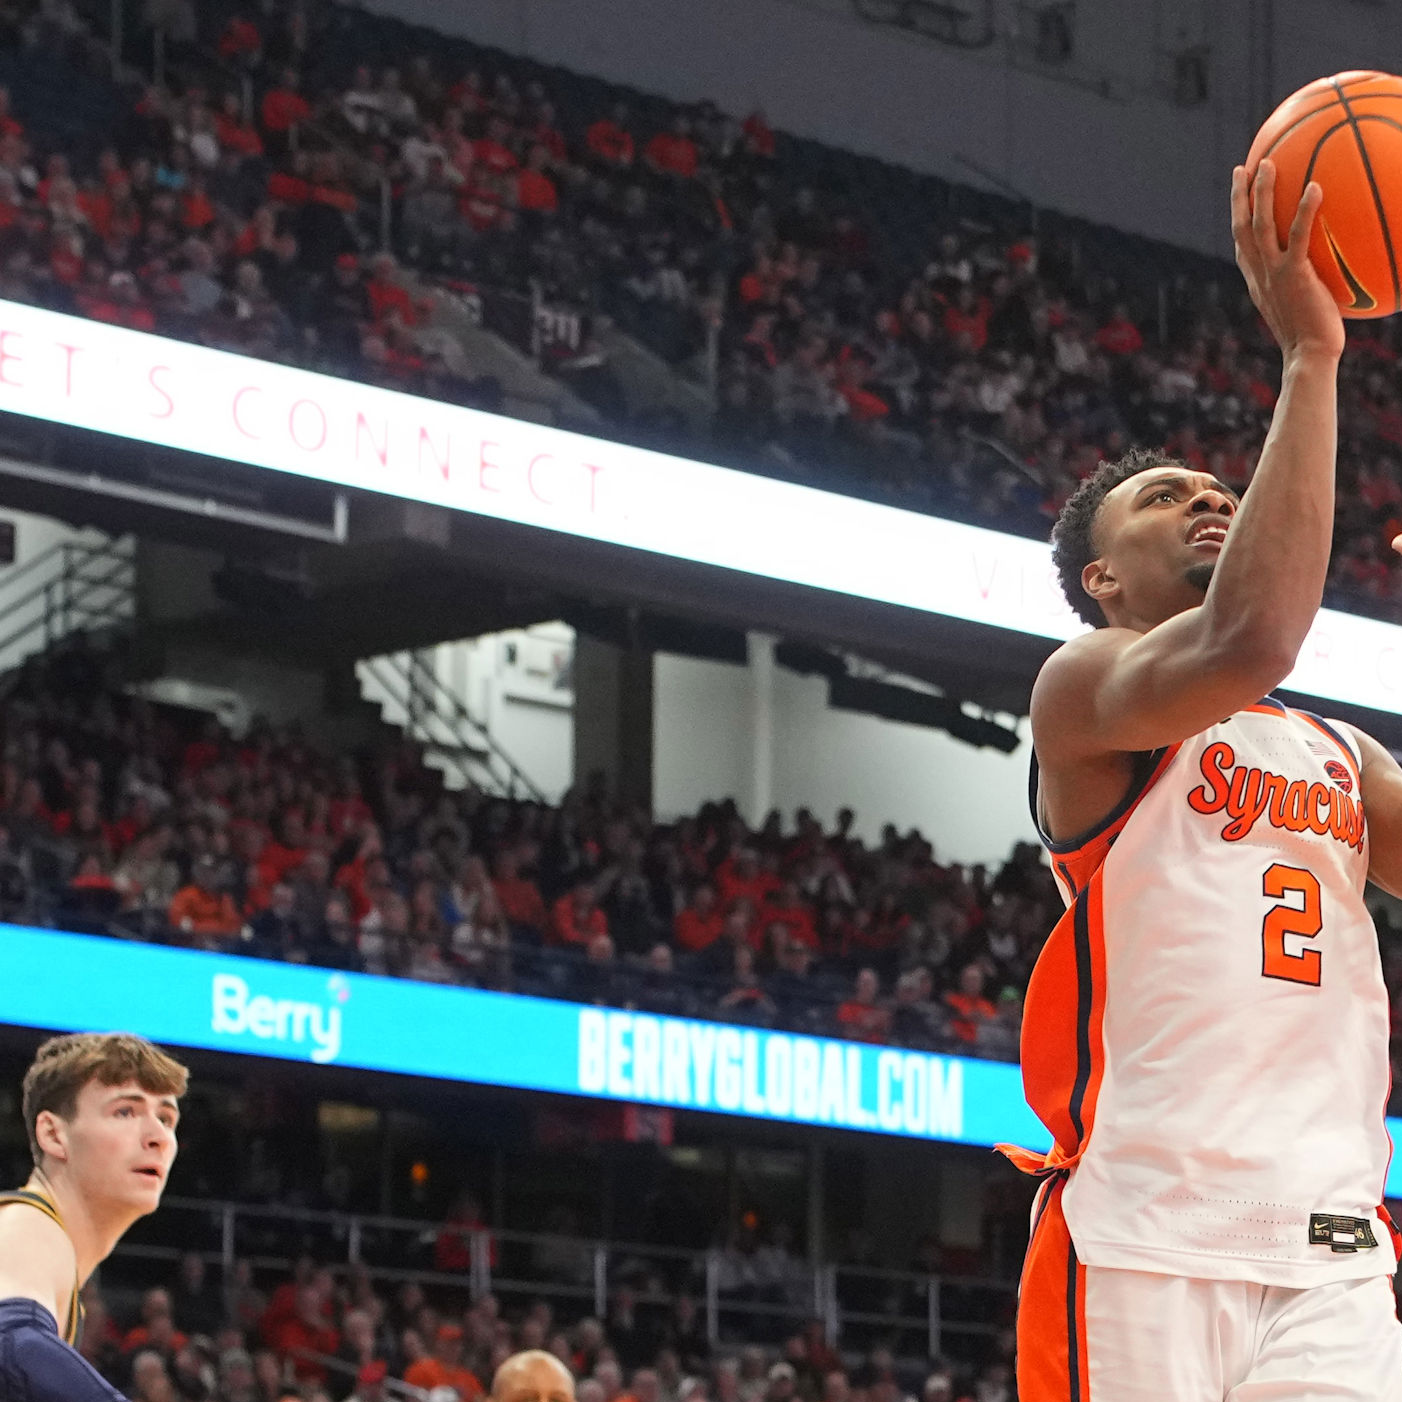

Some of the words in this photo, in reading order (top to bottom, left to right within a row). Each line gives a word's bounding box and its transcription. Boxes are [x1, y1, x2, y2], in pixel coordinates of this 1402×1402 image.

[1261, 863, 1323, 986] 2
[212, 970, 342, 1063] Berry
[578, 1003, 962, 1139] BERRYGLOBAL.COM
